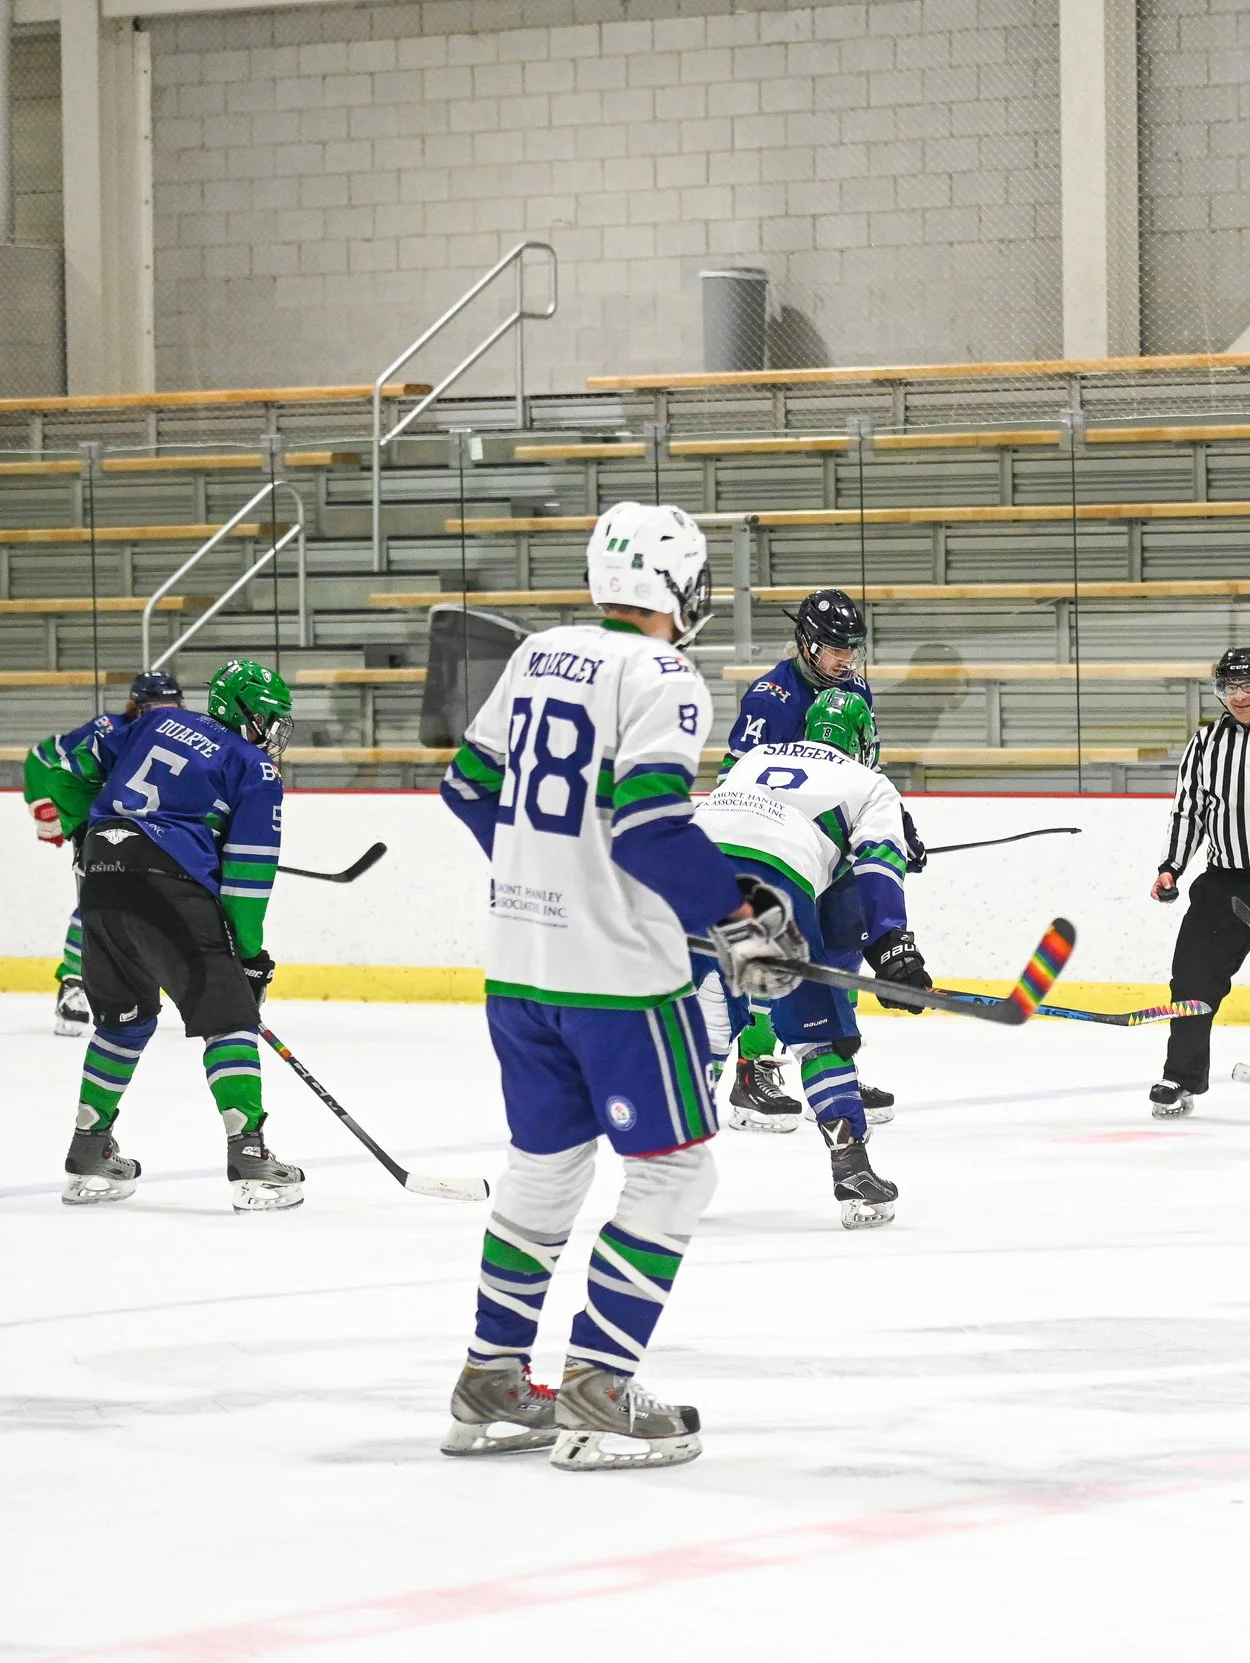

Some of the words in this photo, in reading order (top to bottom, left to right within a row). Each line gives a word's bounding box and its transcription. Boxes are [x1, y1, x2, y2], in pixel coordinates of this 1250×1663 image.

[156, 719, 220, 759] DUARTE
[741, 714, 767, 745] 14
[763, 743, 851, 766] SARGENT
[112, 745, 189, 818] 5
[747, 793, 785, 811] HANLEY
